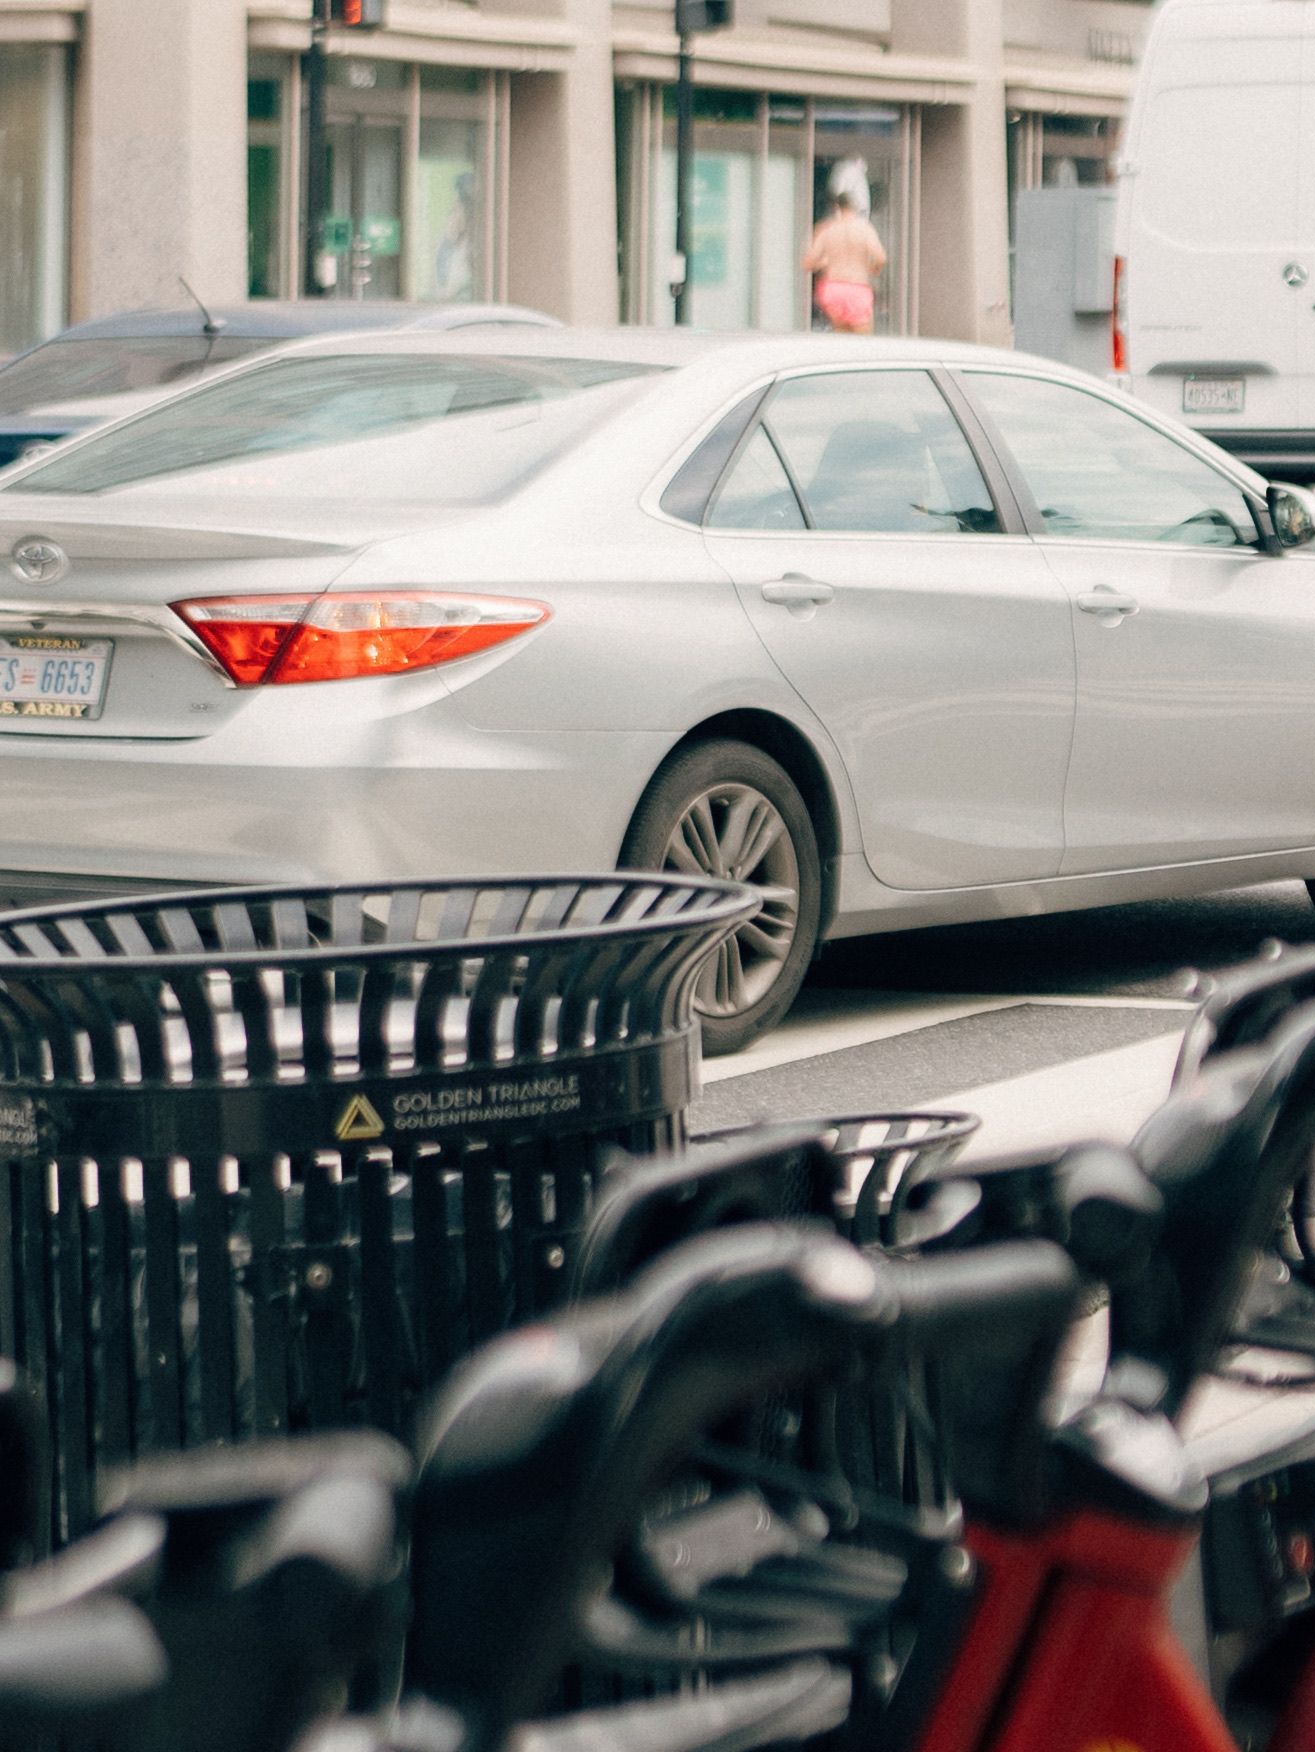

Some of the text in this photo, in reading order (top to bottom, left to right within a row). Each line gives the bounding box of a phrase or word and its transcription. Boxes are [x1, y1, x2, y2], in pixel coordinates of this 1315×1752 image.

[18, 638, 81, 649] VETERAN
[0, 658, 95, 695] S 6653
[0, 701, 88, 717] .S. ARMY
[393, 1075, 580, 1113] GOLDEN TRIANGLE
